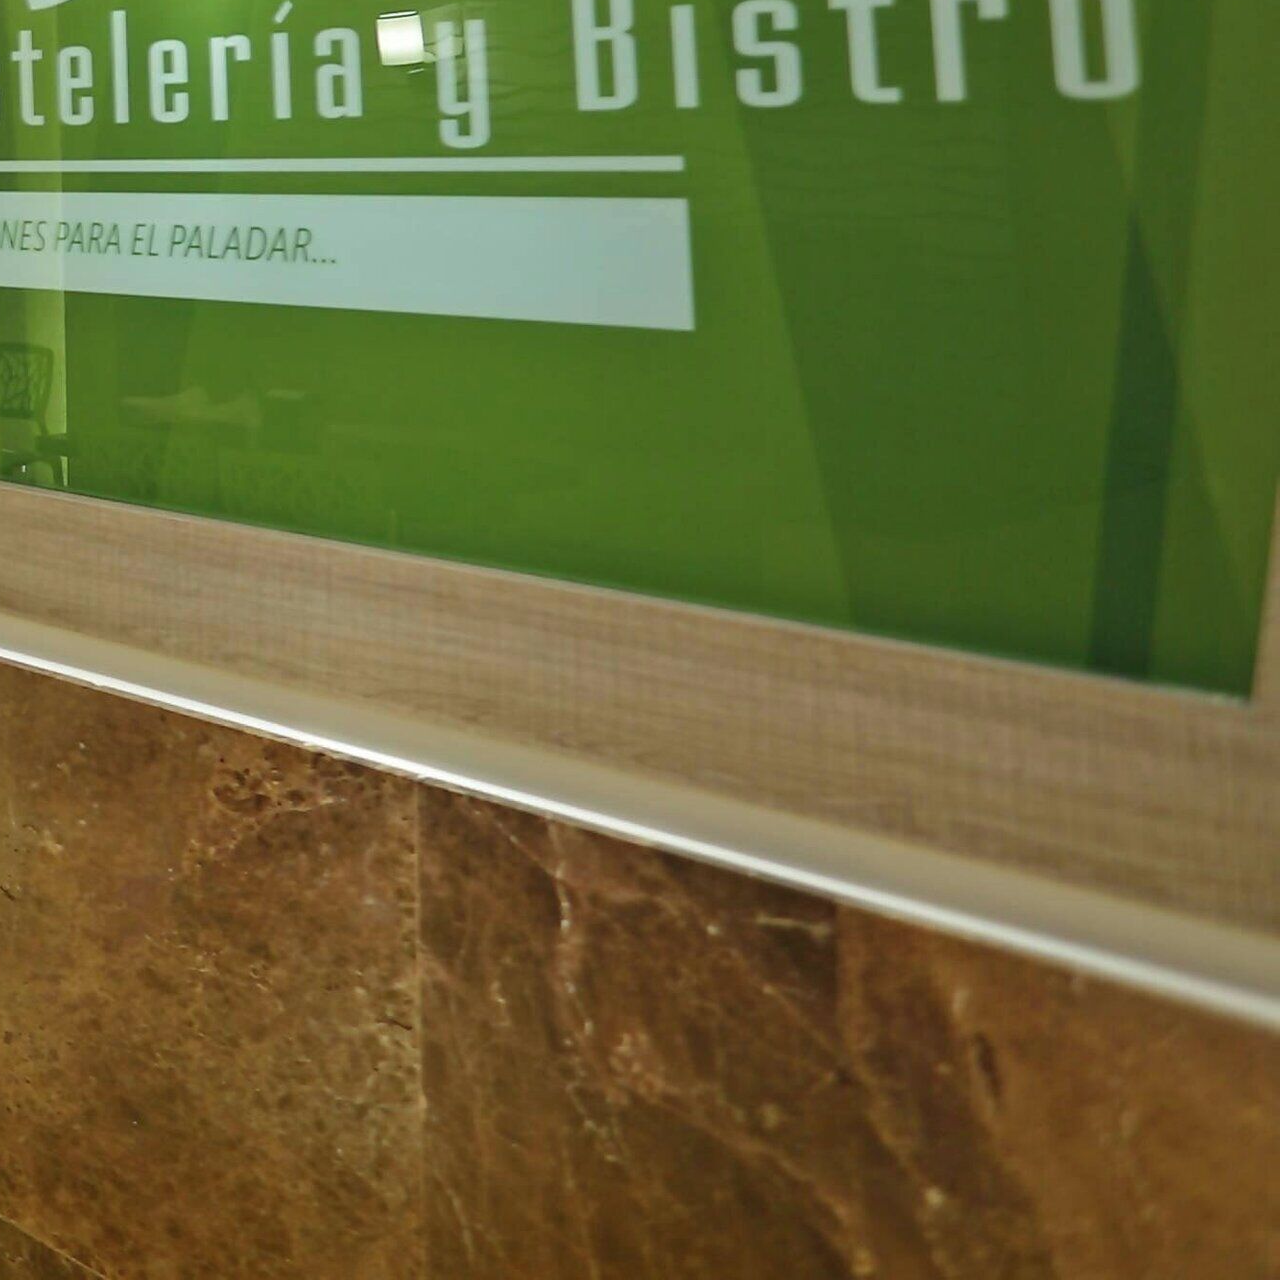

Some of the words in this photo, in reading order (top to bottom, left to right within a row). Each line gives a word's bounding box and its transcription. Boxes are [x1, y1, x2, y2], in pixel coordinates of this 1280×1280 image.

[438, 19, 491, 149] y
[55, 221, 121, 256] PARA
[131, 223, 159, 257] EL
[168, 223, 337, 264] PALADAR...
